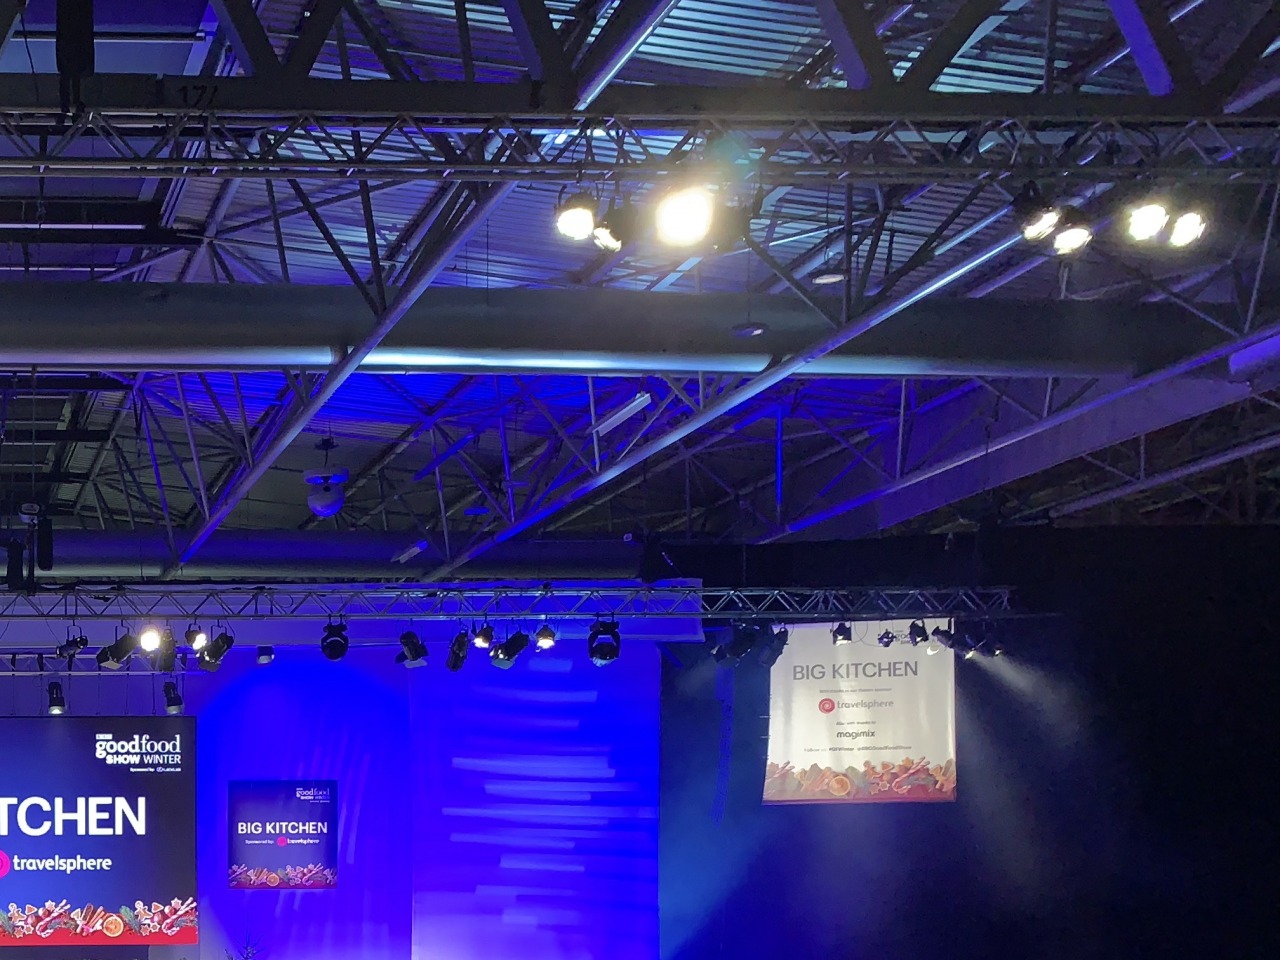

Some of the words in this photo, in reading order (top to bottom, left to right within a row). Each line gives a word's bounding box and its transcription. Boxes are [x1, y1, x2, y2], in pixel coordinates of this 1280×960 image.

[793, 664, 825, 680] BIG
[832, 661, 918, 679] KITCHEN
[837, 700, 894, 710] travelsphere
[836, 730, 876, 740] magimix
[106, 754, 140, 764] SHOW
[143, 754, 181, 764] WINTER
[238, 822, 262, 834] BIG
[266, 822, 328, 834] KITCHEN
[13, 854, 112, 874] travelsphere
